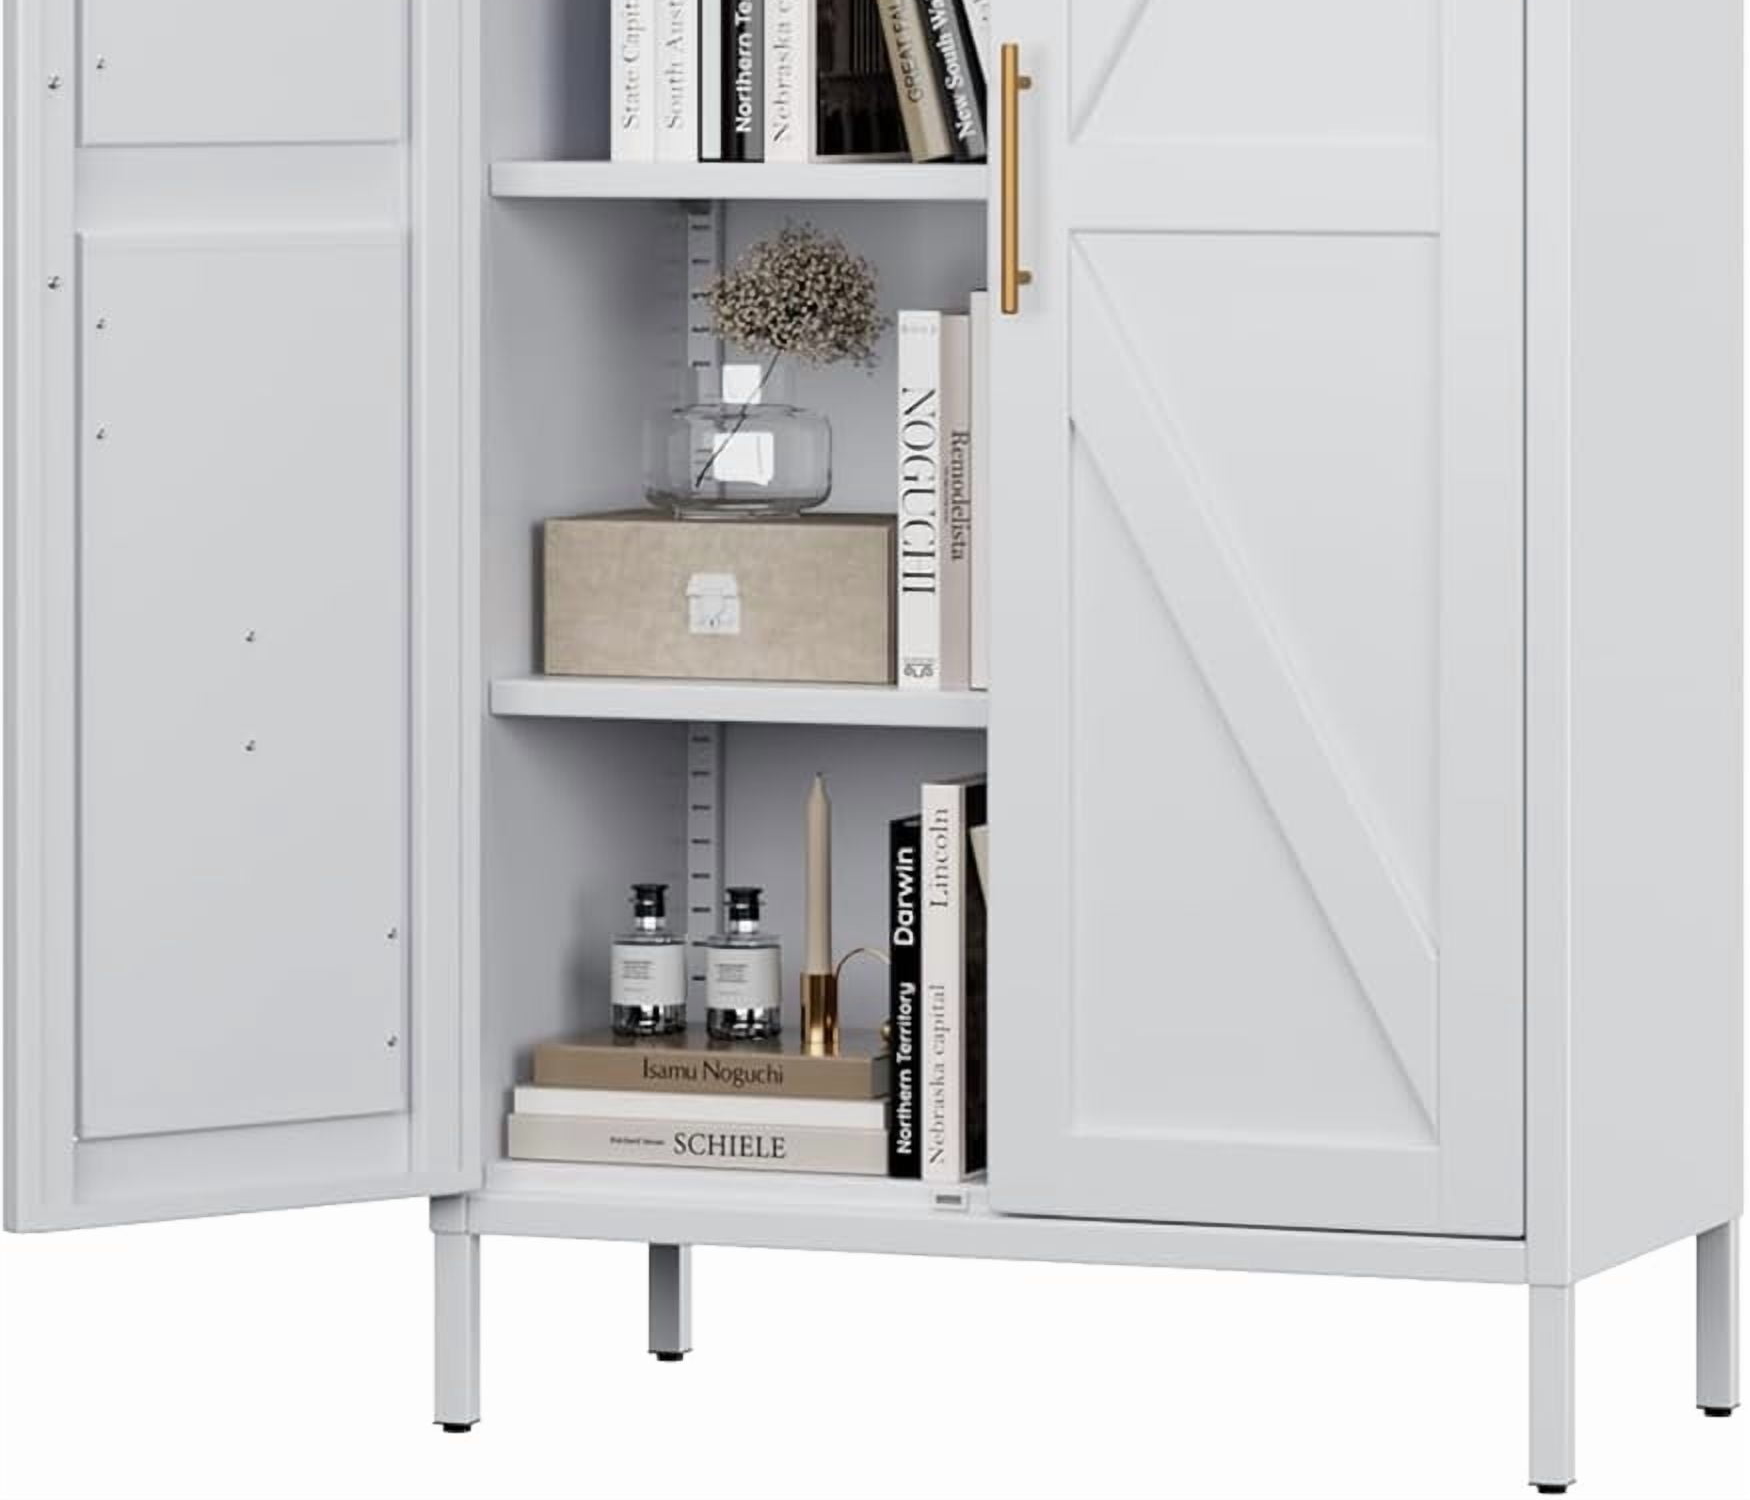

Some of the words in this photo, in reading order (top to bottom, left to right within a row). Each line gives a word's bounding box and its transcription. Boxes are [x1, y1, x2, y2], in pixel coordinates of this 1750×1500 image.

[622, 72, 641, 130] State
[665, 59, 686, 130] South
[734, 26, 753, 134] Northern
[773, 18, 793, 143] Nebraska
[896, 39, 924, 104] GREAT
[935, 32, 965, 90] South
[953, 93, 977, 140] New
[901, 387, 936, 593] NOGUCHI
[951, 431, 971, 561] Remodelista
[893, 846, 915, 947] Darwin
[929, 807, 949, 908] Lincoln
[896, 981, 917, 1063] Territory
[928, 983, 951, 1057] capital
[643, 1057, 698, 1082] Isamu
[702, 1060, 784, 1090] Noguchi
[896, 1068, 913, 1155] Northern
[928, 1061, 946, 1165] Nebraska
[672, 1132, 787, 1159] SCHIELE
